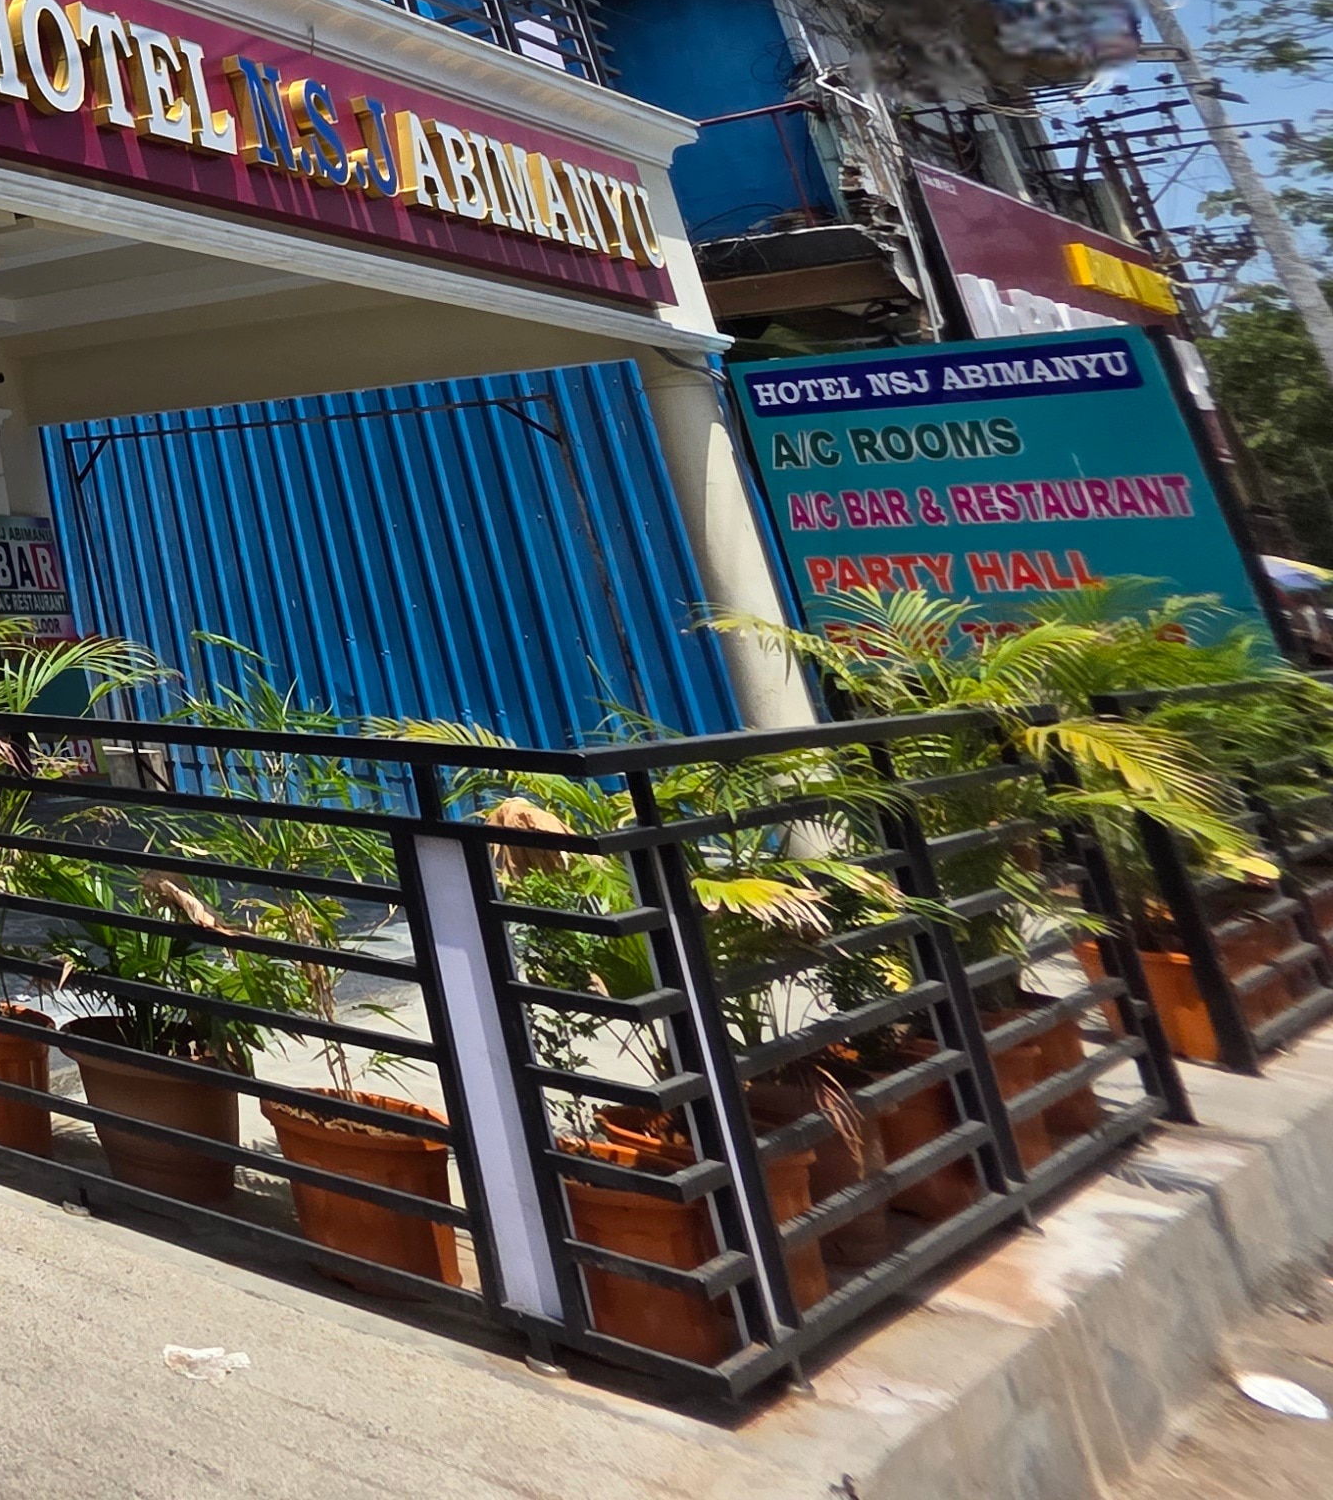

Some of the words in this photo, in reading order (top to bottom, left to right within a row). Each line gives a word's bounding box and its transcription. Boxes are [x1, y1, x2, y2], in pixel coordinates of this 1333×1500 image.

[222, 54, 400, 198] N.S.J
[395, 110, 665, 269] ABIMANYU
[753, 375, 861, 406] HOTEL
[871, 369, 930, 396] NSJ
[941, 350, 1129, 391] ABIMANYU
[772, 430, 841, 469] A/C
[848, 416, 1023, 464] ROOMS
[788, 491, 840, 531] A/C
[841, 486, 913, 529] BAR
[919, 486, 946, 526] &
[948, 472, 1195, 525] RESTAURANT
[805, 552, 953, 595] PARTY
[966, 550, 1108, 593] HALL
[12, 593, 67, 612] RESTAURANT
